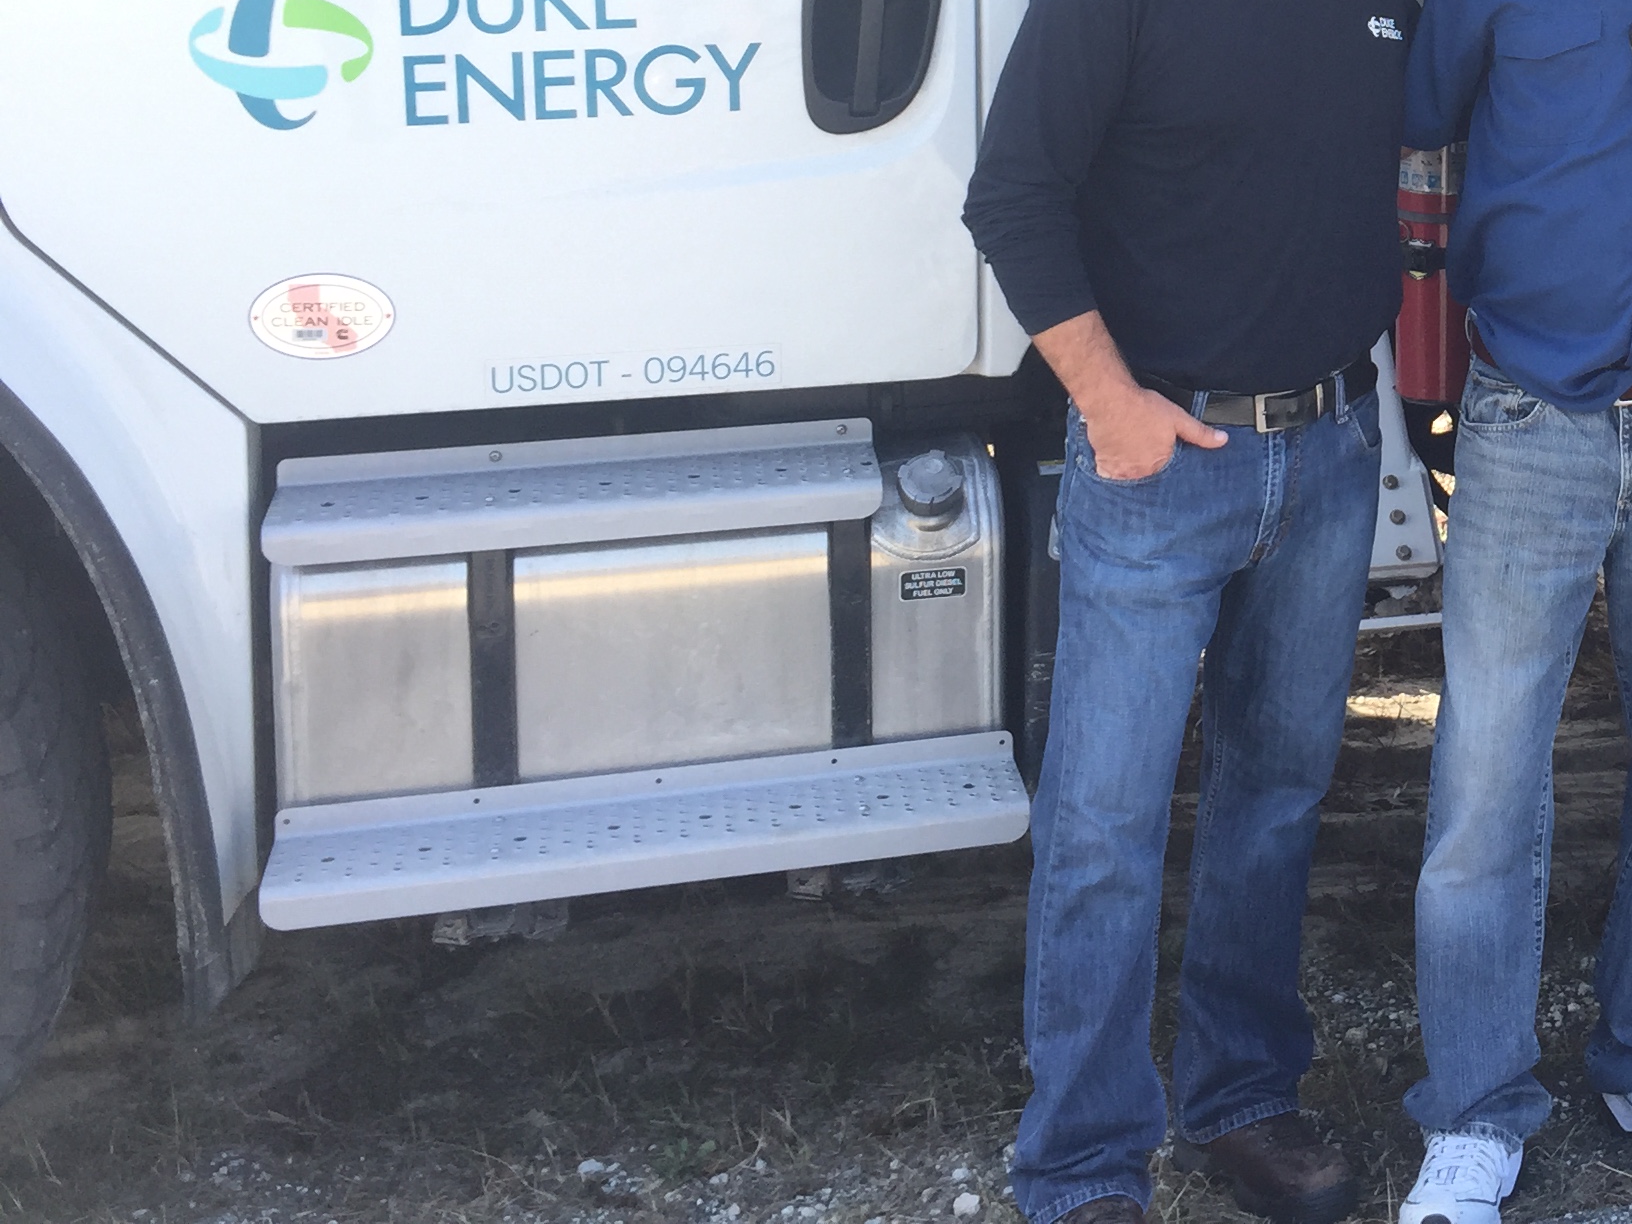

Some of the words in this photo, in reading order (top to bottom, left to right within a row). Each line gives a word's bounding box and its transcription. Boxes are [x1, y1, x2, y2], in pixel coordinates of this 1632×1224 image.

[402, 42, 763, 127] ENERGY
[279, 301, 366, 314] CERTIFIED
[271, 316, 329, 328] CLEAN
[337, 315, 373, 327] IDLE
[491, 359, 610, 394] USDOT
[644, 350, 776, 384] 094646
[911, 572, 937, 580] ULTRA
[937, 570, 956, 578] LOW
[904, 580, 935, 589] SULFUR
[935, 578, 963, 587] DIESEL
[912, 589, 933, 597] FUEL
[933, 587, 954, 595] ONLY
